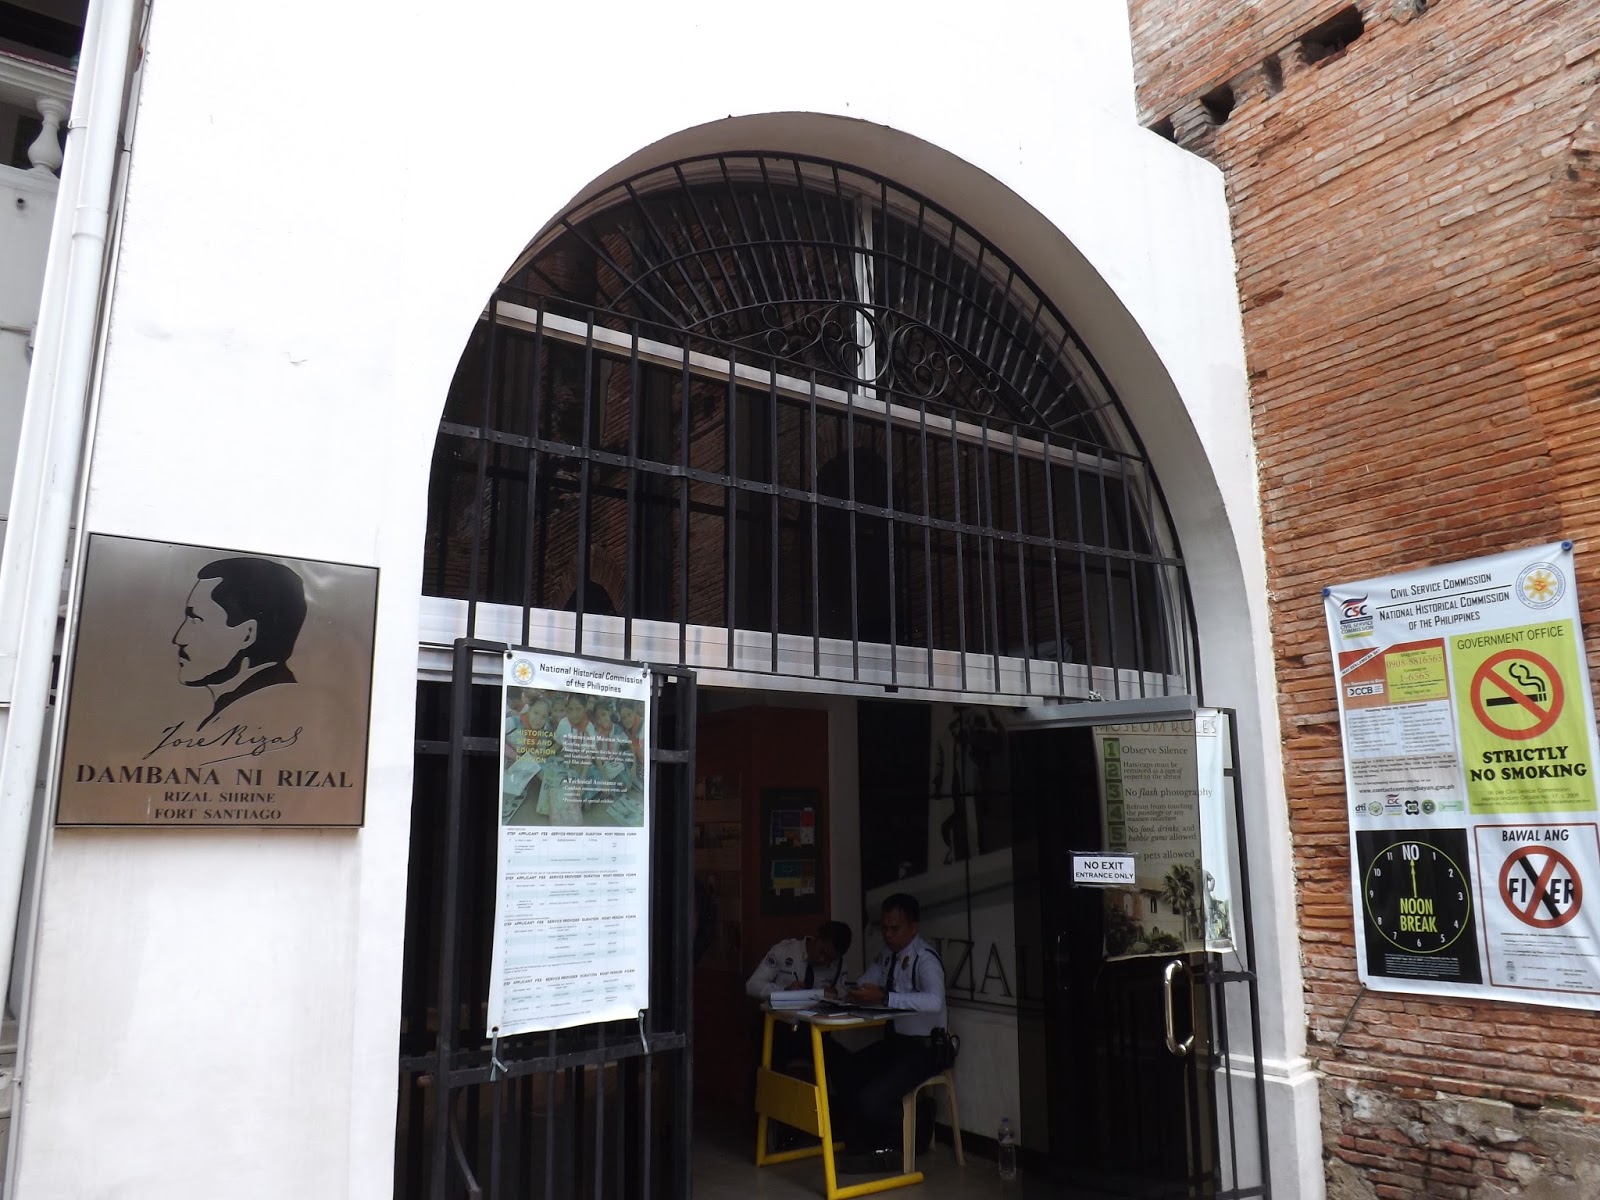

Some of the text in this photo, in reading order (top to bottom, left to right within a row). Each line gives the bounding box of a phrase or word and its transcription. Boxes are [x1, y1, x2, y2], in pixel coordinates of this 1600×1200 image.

[1390, 574, 1492, 599] CIVIL SERVICE COMMISSION
[1344, 604, 1368, 618] CSC
[1379, 606, 1414, 620] NATIONAL
[1415, 599, 1458, 615] HISTORICAL
[1460, 592, 1510, 608] COMMISSION
[1408, 611, 1480, 630] OF THE PHILIPPINES
[1457, 626, 1564, 650] GOVERNMENT OFFICE
[540, 663, 571, 675] National
[573, 667, 604, 679] Historical
[605, 672, 643, 684] Commission
[574, 679, 585, 688] the
[587, 681, 621, 693] Philippines
[517, 730, 556, 738] HISTORICAL
[1108, 742, 1116, 757] 1
[1122, 746, 1188, 754] Observe Silence
[1482, 746, 1568, 764] STRICTLY
[76, 764, 354, 788] DAMBANA NI RIZAL
[1108, 764, 1118, 778] 2
[1470, 764, 1587, 782] NO SMOKING
[164, 791, 276, 803] RIZAL SHRINE
[1109, 785, 1120, 798] 3
[1138, 788, 1158, 798] flash
[1161, 788, 1212, 798] photography
[154, 808, 282, 820] FORT SANTIAGO
[1110, 806, 1122, 820] 4
[1112, 827, 1123, 840] 5
[1502, 829, 1570, 842] BAWAL ANG
[1144, 852, 1160, 861] pets
[1387, 852, 1393, 860] 11
[1402, 844, 1420, 860] NO
[1432, 852, 1436, 860] 1
[1084, 861, 1124, 870] NO EXIT
[1374, 868, 1381, 876] 10
[1448, 869, 1454, 877] 2
[1370, 890, 1374, 898] 9
[1458, 892, 1463, 900] 3
[1400, 898, 1434, 915] NOON
[1378, 917, 1382, 925] 8
[1400, 915, 1438, 933] BREAK
[1454, 920, 1459, 929] 4
[1393, 932, 1397, 940] 7
[1441, 934, 1445, 942] 5
[1417, 939, 1421, 947] 6
